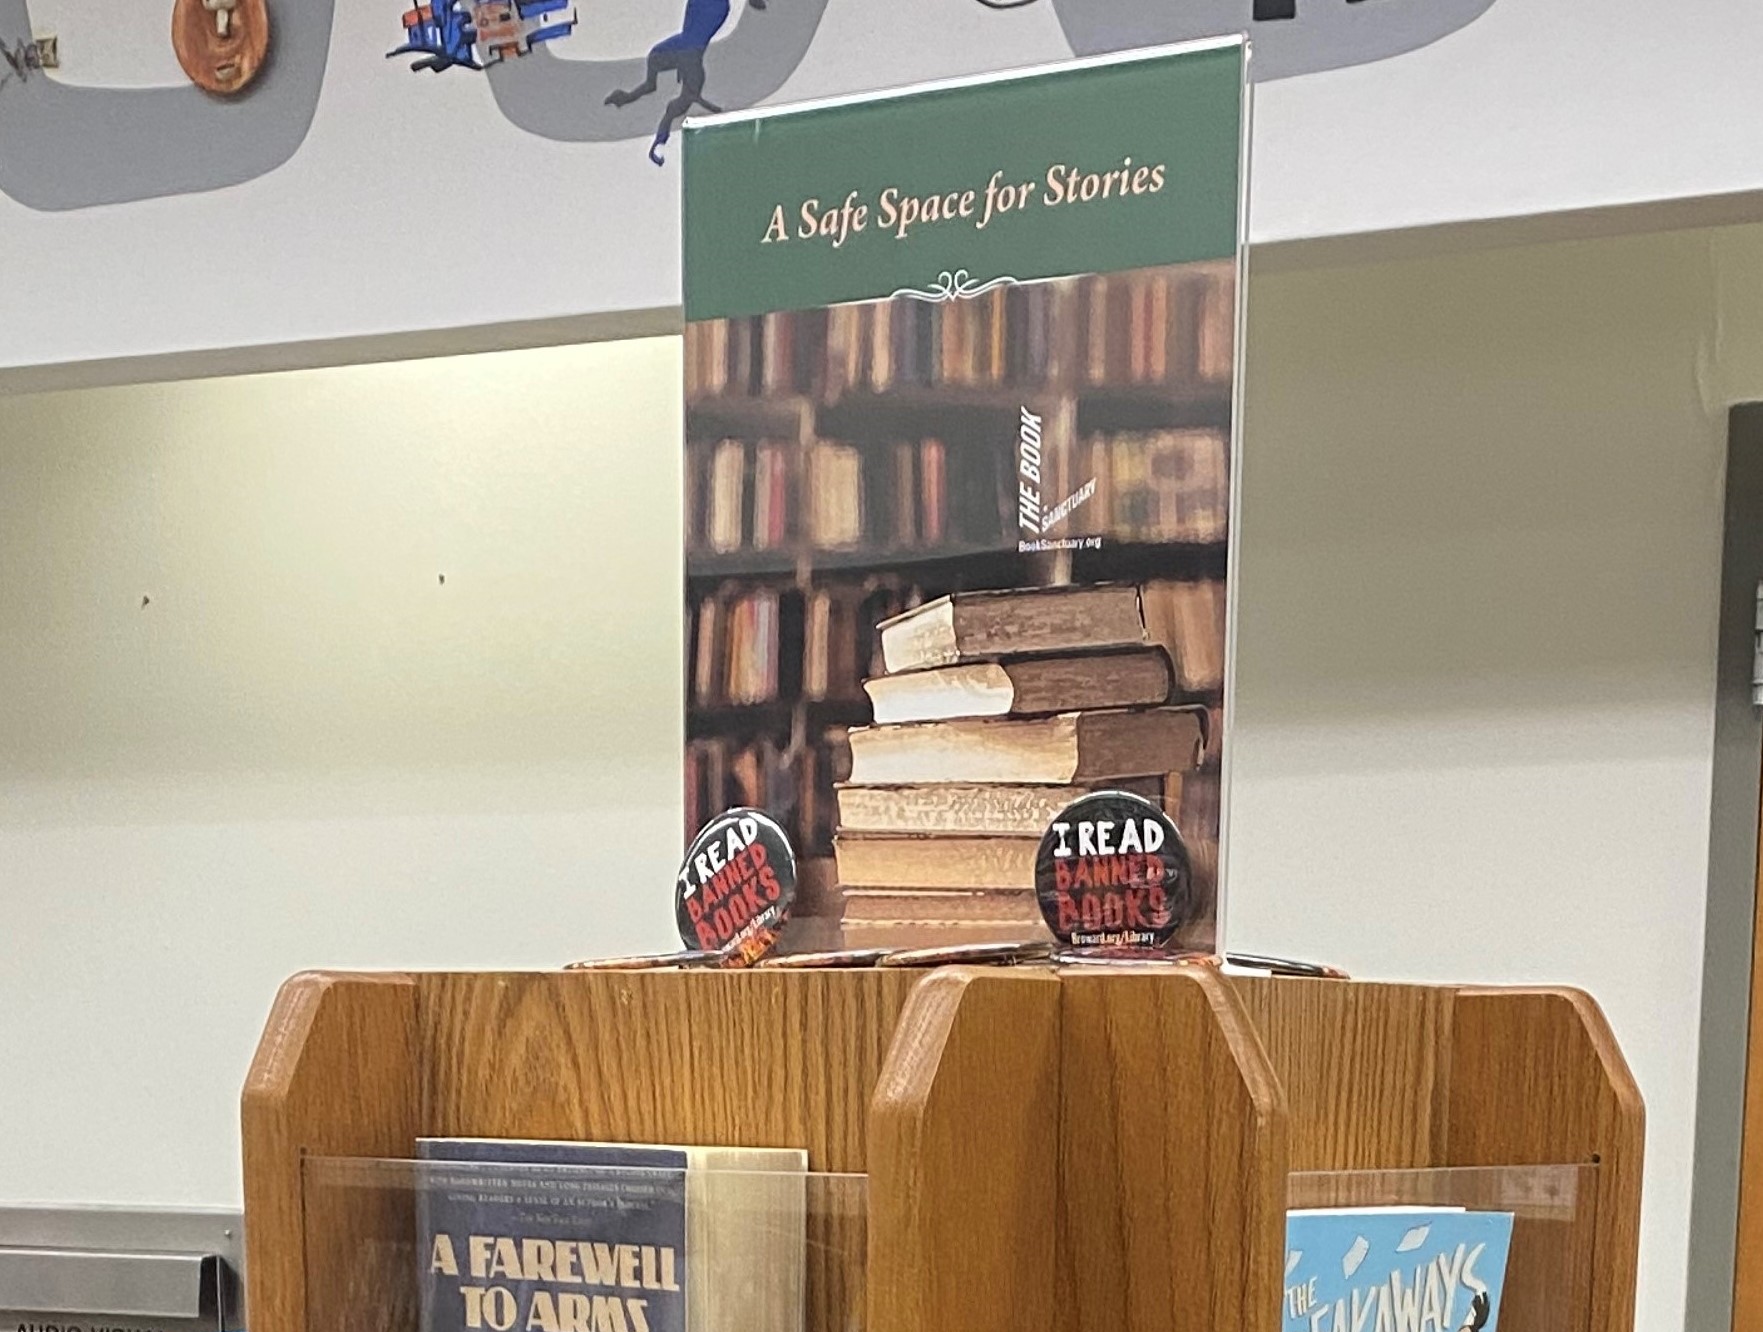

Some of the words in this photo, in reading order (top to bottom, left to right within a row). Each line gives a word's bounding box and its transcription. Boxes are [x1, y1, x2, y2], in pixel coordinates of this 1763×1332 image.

[762, 205, 788, 243] A
[799, 191, 867, 247] Safe
[878, 188, 973, 239] Space
[976, 171, 1035, 229] for
[1043, 158, 1166, 205] Stories
[1020, 405, 1042, 484] BOOK
[1019, 482, 1040, 534] THE
[1041, 477, 1097, 533] SANCTUARY
[679, 866, 696, 900] I
[694, 817, 758, 884] READ
[1052, 821, 1072, 857] I
[1078, 818, 1165, 857] READ
[686, 843, 767, 923] BANNED
[1055, 854, 1165, 890] BANNED
[696, 866, 780, 950] BOOKS
[1058, 887, 1172, 931] BOOKS
[430, 1234, 459, 1276] A
[469, 1235, 680, 1292] FAREWELL
[460, 1285, 517, 1332] TO
[1287, 1276, 1317, 1320] THE
